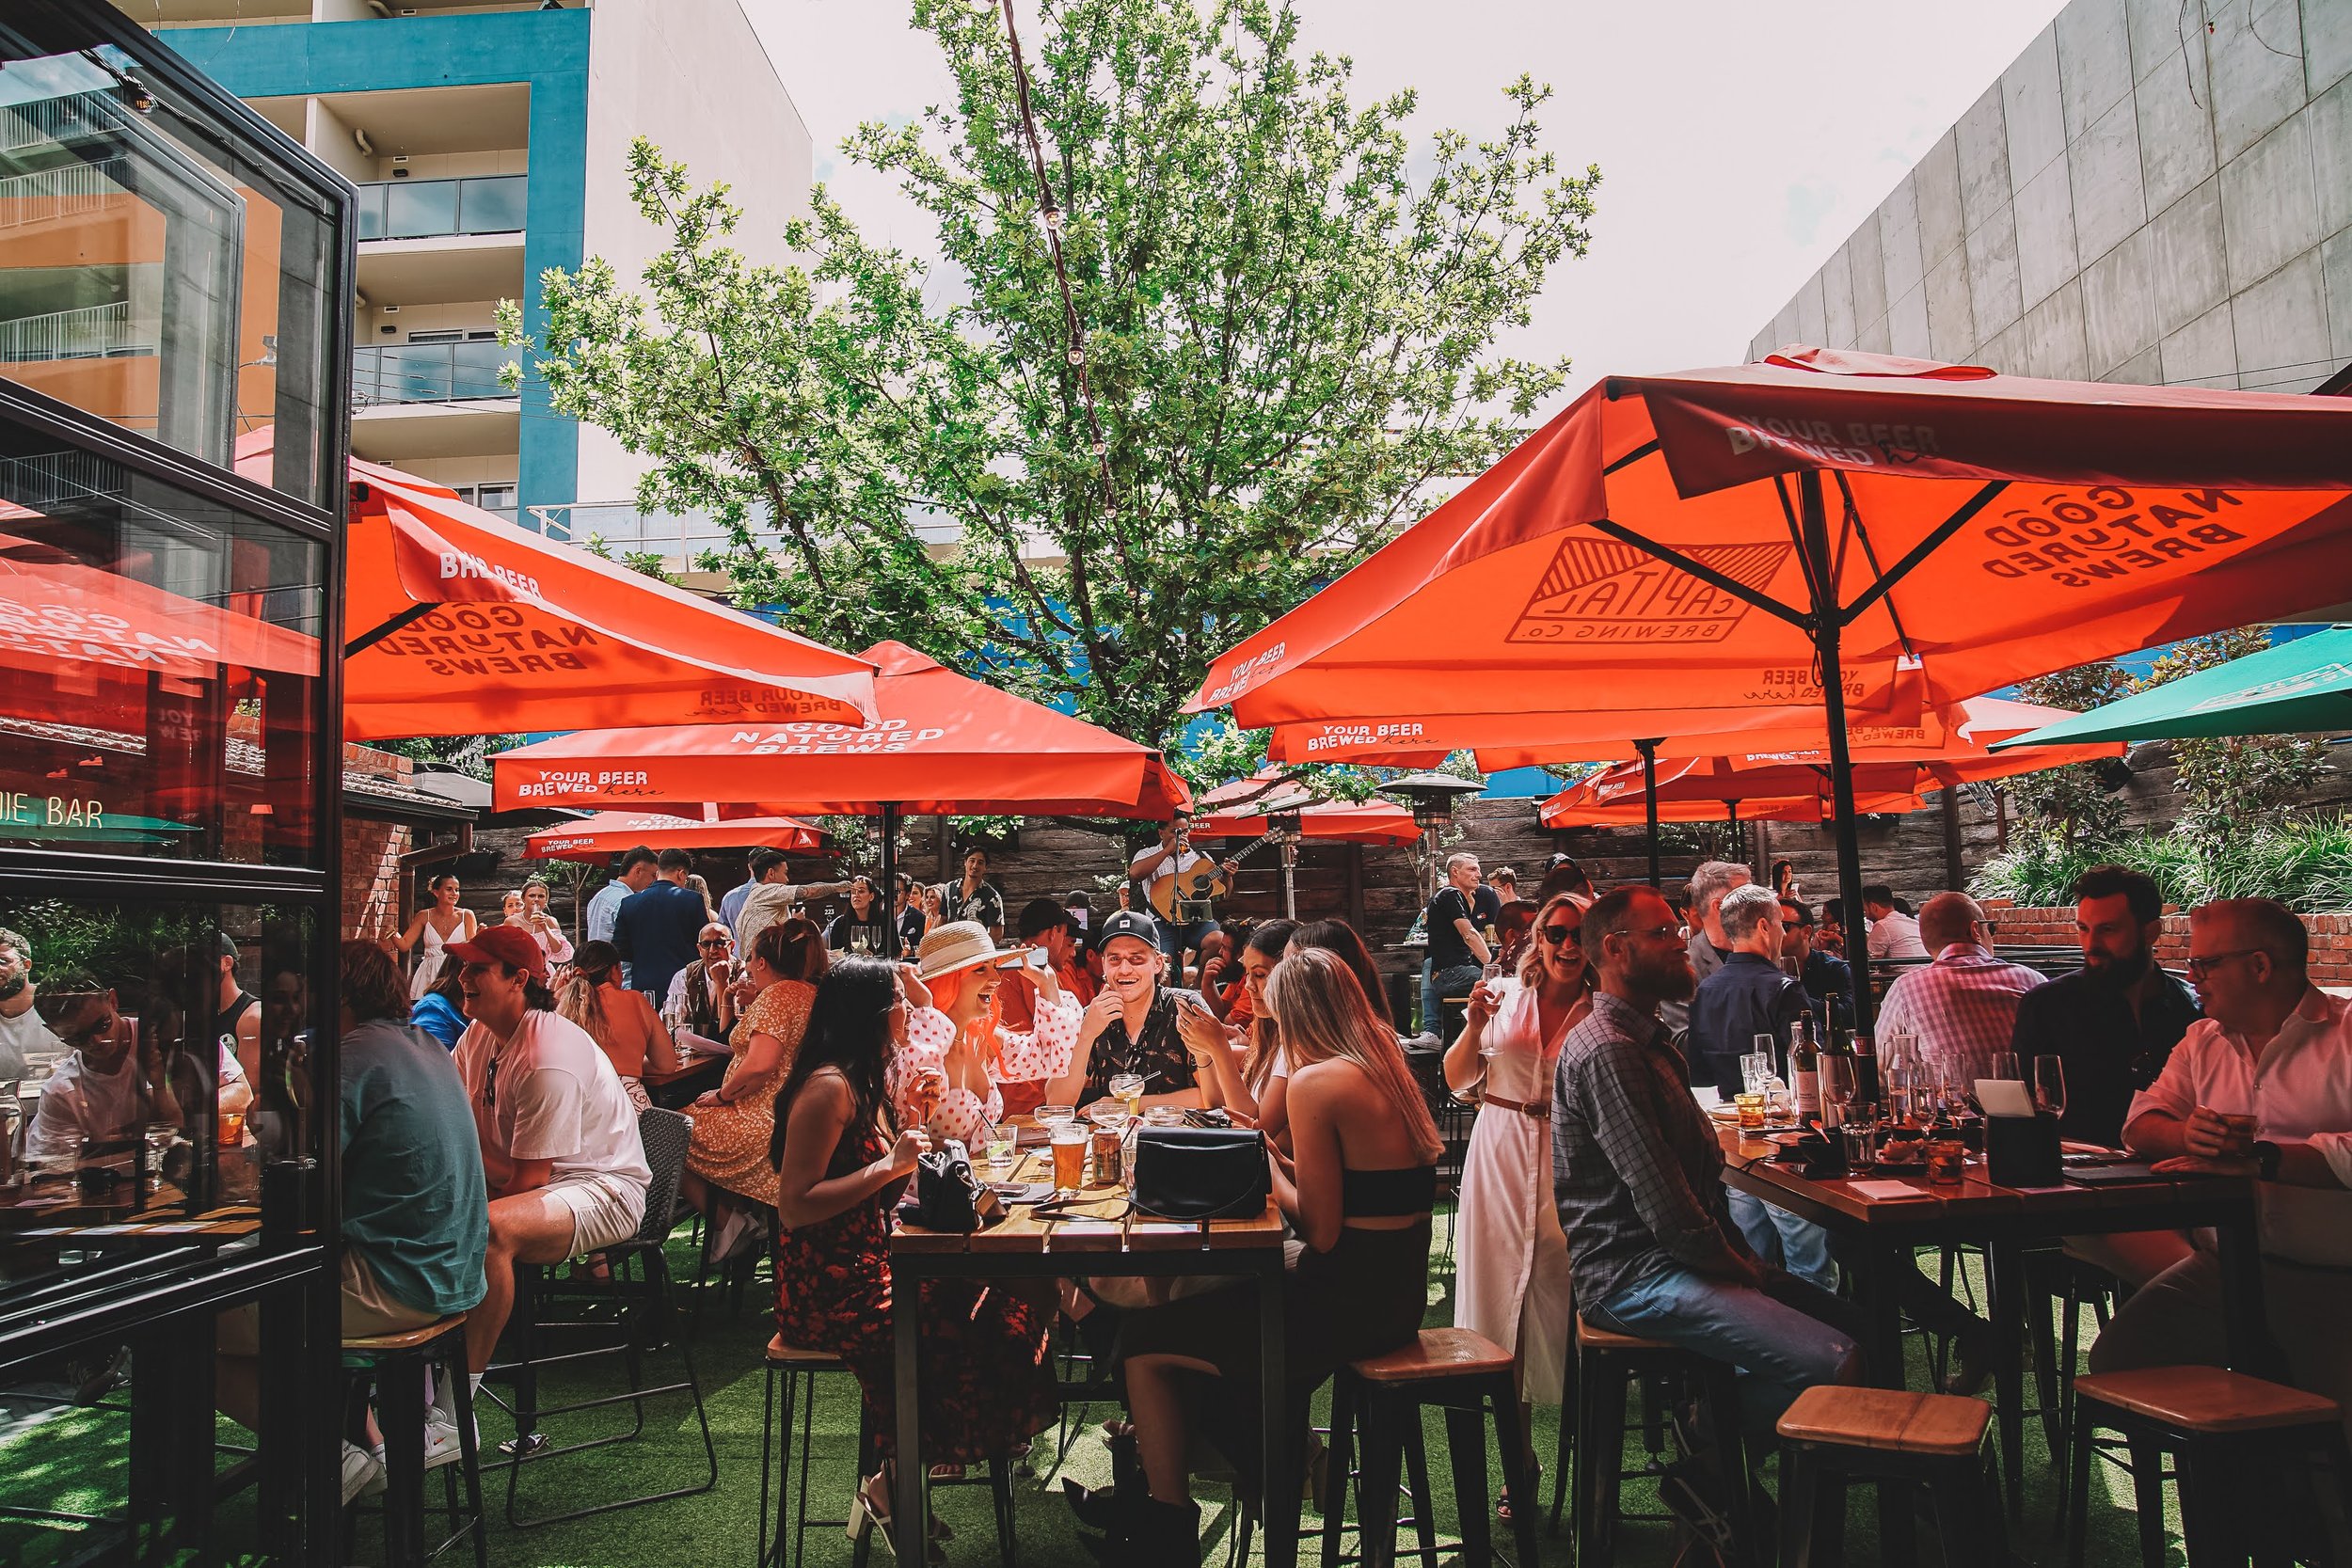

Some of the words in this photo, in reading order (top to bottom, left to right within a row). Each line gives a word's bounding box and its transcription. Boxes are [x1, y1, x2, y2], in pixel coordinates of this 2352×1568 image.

[1740, 415, 1840, 445] YOUR
[1847, 423, 1940, 452] BEER
[1254, 641, 1286, 667] BEER
[1207, 671, 1251, 704] BREWE
[730, 728, 946, 745] NATURED
[1323, 725, 1371, 736] YOUR
[1377, 722, 1423, 736] BEER
[749, 742, 908, 753] BREWS
[1308, 735, 1378, 751] BREWED
[1382, 731, 1439, 745] here
[539, 770, 591, 784] YOUR
[597, 770, 648, 785] BEER
[518, 782, 598, 797] BREWED
[603, 780, 665, 796] here
[47, 796, 103, 829] BAR
[541, 844, 573, 853] BREWED
